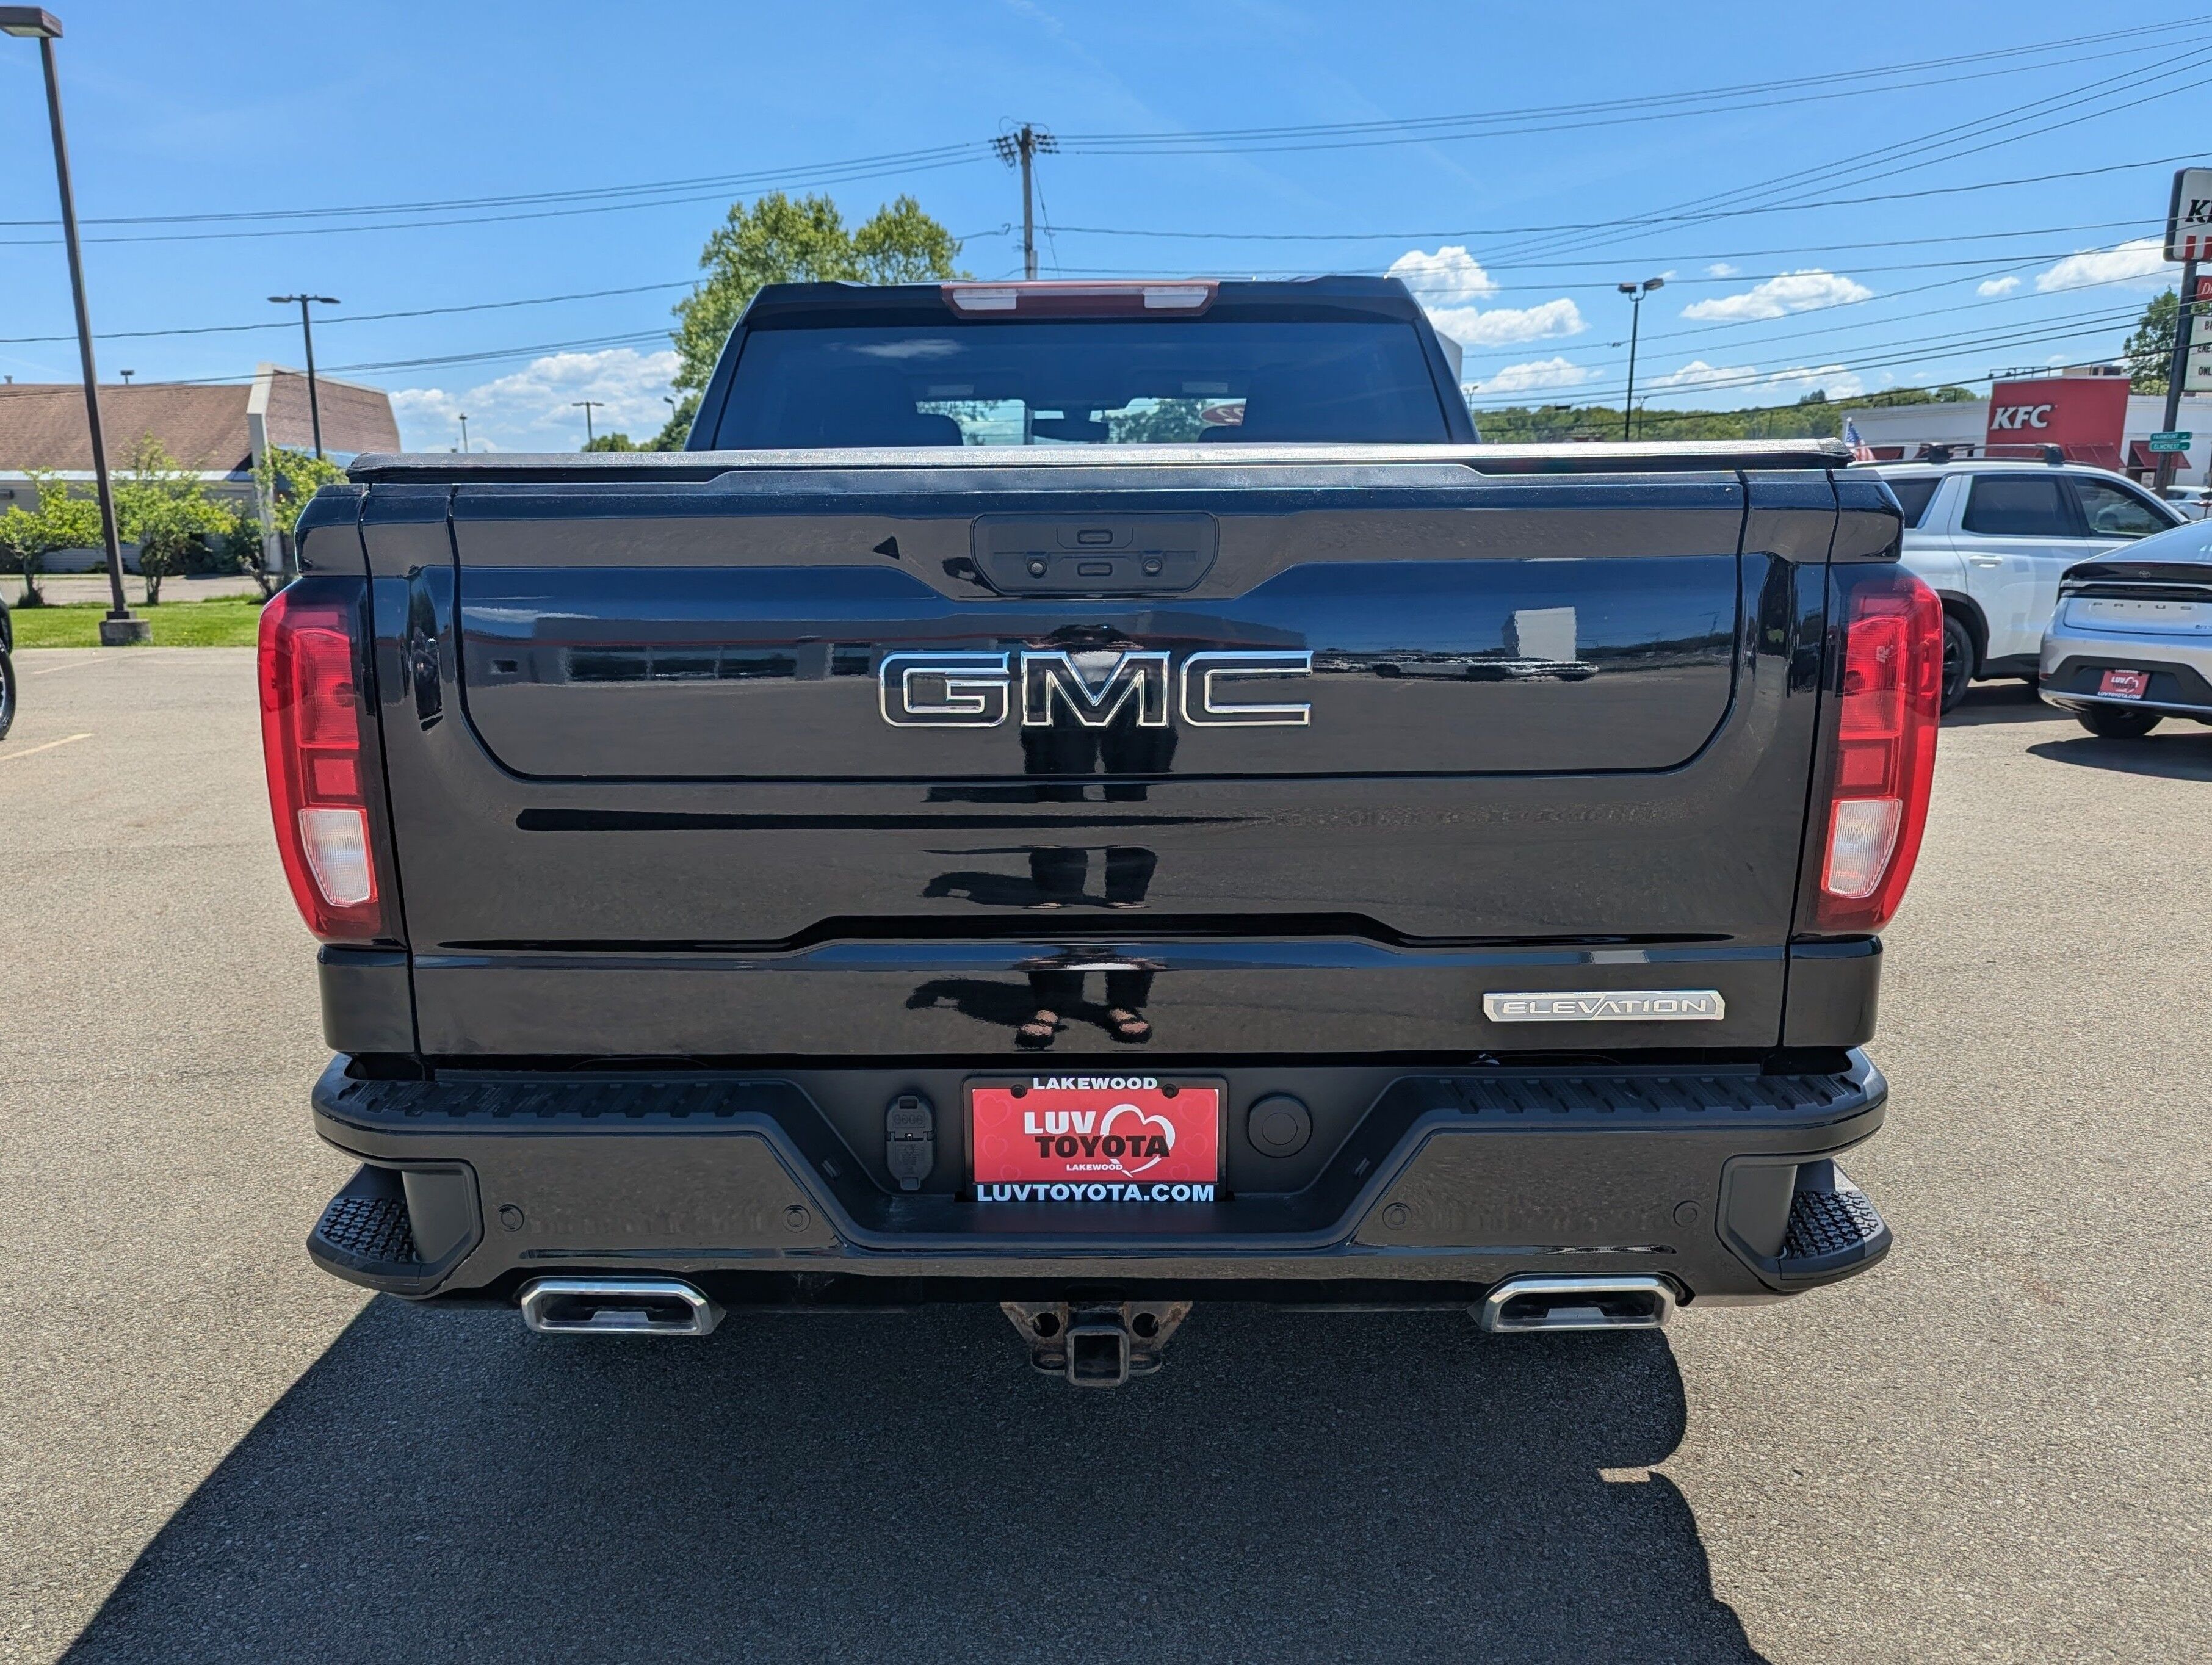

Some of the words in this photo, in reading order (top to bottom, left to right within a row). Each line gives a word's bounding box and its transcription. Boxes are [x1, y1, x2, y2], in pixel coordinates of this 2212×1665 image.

[2185, 199, 2212, 223] K
[2201, 283, 2212, 294] D
[1990, 405, 2051, 430] KFC
[2093, 602, 2192, 610] PRIUS
[878, 650, 1314, 727] GMC
[1502, 999, 1707, 1014] ELEVATION
[1033, 1077, 1158, 1090] LAKEWOOD
[1024, 1111, 1096, 1134] LUV
[1035, 1135, 1171, 1158] TOYOTA
[977, 1183, 1215, 1202] LUVTOYOTA.COM
